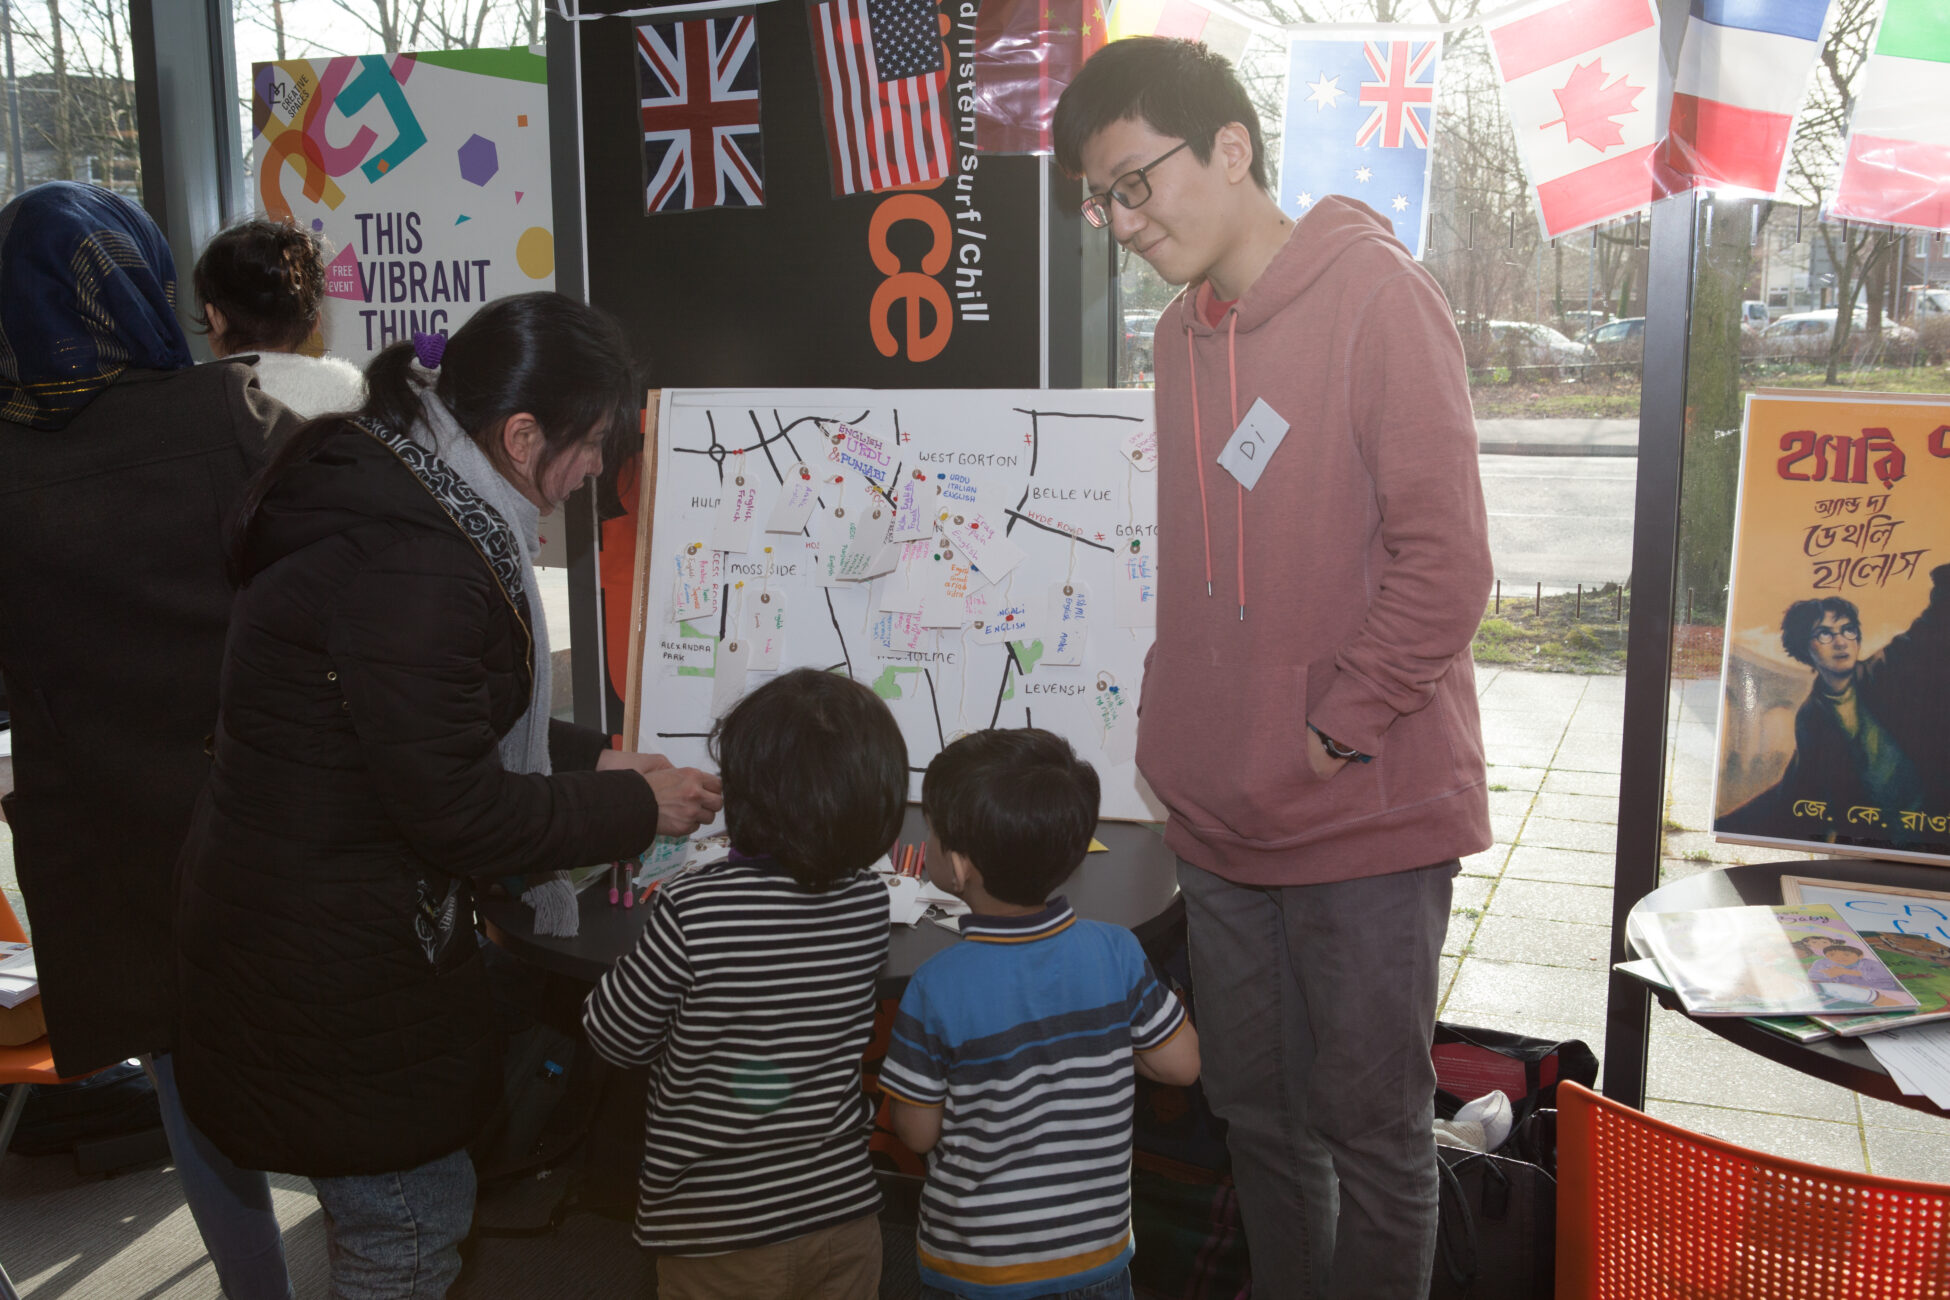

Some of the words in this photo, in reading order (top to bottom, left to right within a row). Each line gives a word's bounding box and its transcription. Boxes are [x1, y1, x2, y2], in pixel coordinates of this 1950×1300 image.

[281, 74, 309, 111] CREATIVE
[287, 89, 310, 118] SPACES
[355, 212, 423, 256] THIS
[333, 265, 353, 277] FREE
[328, 281, 354, 293] EVENT
[357, 260, 491, 303] VIBRANT
[359, 309, 448, 351] THING
[839, 423, 883, 450] ENGLISH
[847, 437, 891, 466] URDU
[919, 451, 955, 464] WEST
[958, 452, 1018, 467] GORTON
[1777, 427, 1906, 490] হ্যারি
[840, 452, 886, 481] PUNJABI
[947, 483, 977, 494] ITALIAN
[1033, 487, 1077, 500] BELLE
[1083, 488, 1112, 501] VUE
[943, 490, 976, 504] ENGLISH
[1028, 510, 1054, 526] HYDE
[731, 563, 763, 575] MOSS
[985, 622, 1026, 635] ENGLISH
[661, 641, 711, 653] ALEXANDRA
[663, 652, 685, 661] PARK
[1899, 810, 1950, 832] রাও
